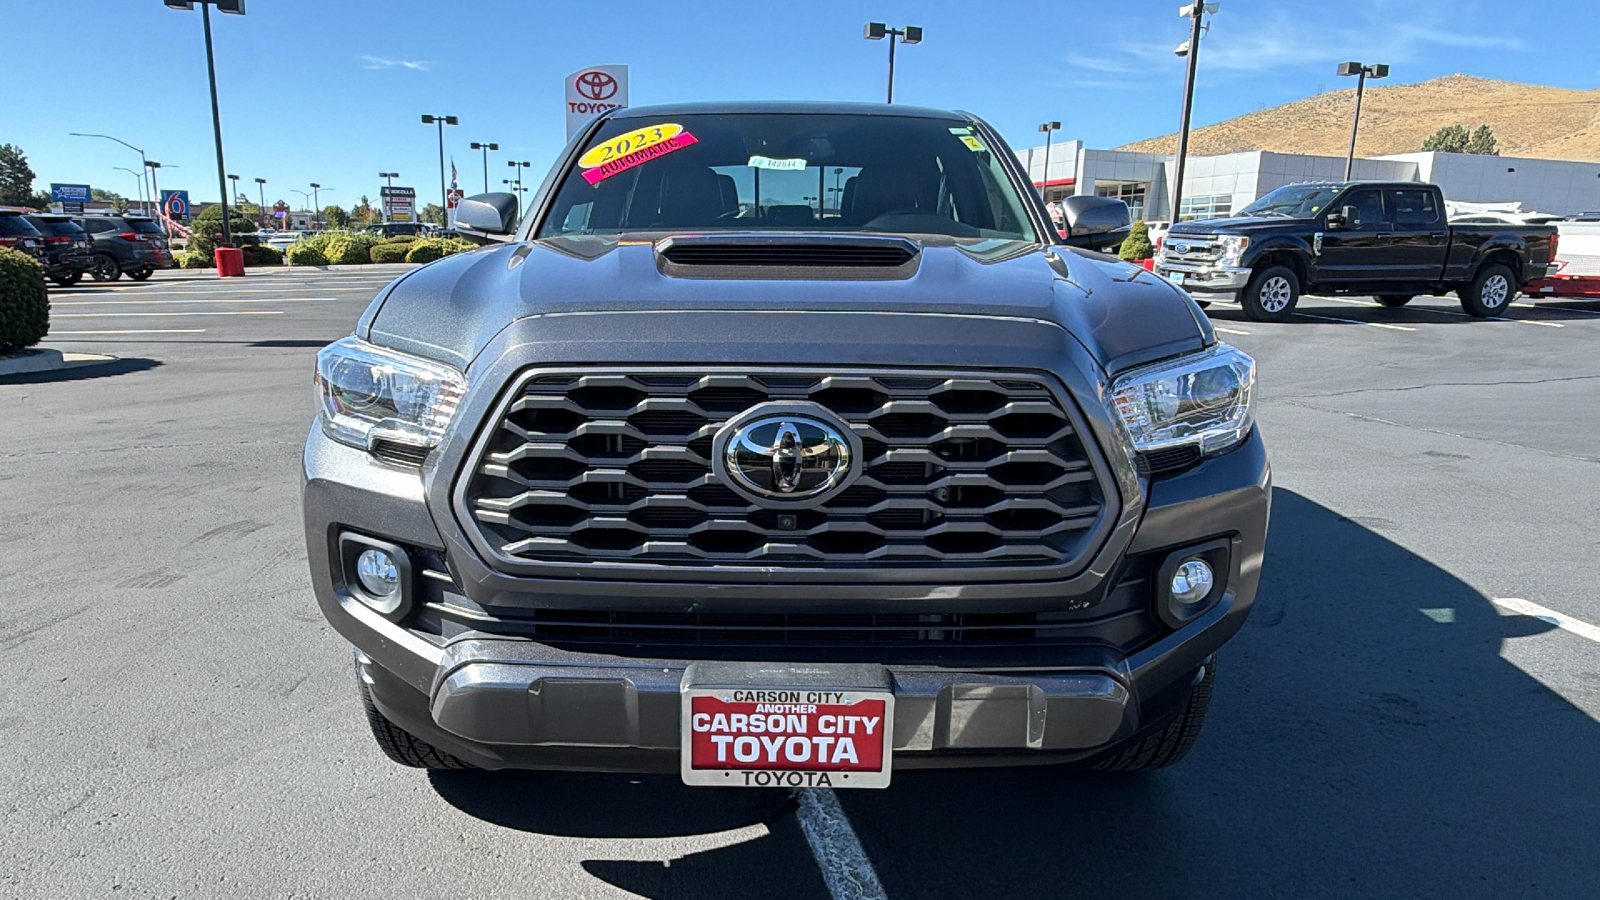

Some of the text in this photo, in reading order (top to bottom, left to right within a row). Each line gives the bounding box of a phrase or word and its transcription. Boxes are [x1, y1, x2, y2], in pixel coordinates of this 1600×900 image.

[568, 102, 622, 114] TOYO
[600, 128, 663, 163] 2023
[600, 137, 680, 176] AUTOMATIC
[733, 690, 844, 704] CARSON CITY
[755, 703, 817, 714] ANOTHER
[692, 712, 880, 735] CARSON CITY
[710, 735, 859, 764] TOYOTA
[741, 771, 832, 787] TOYOTA
